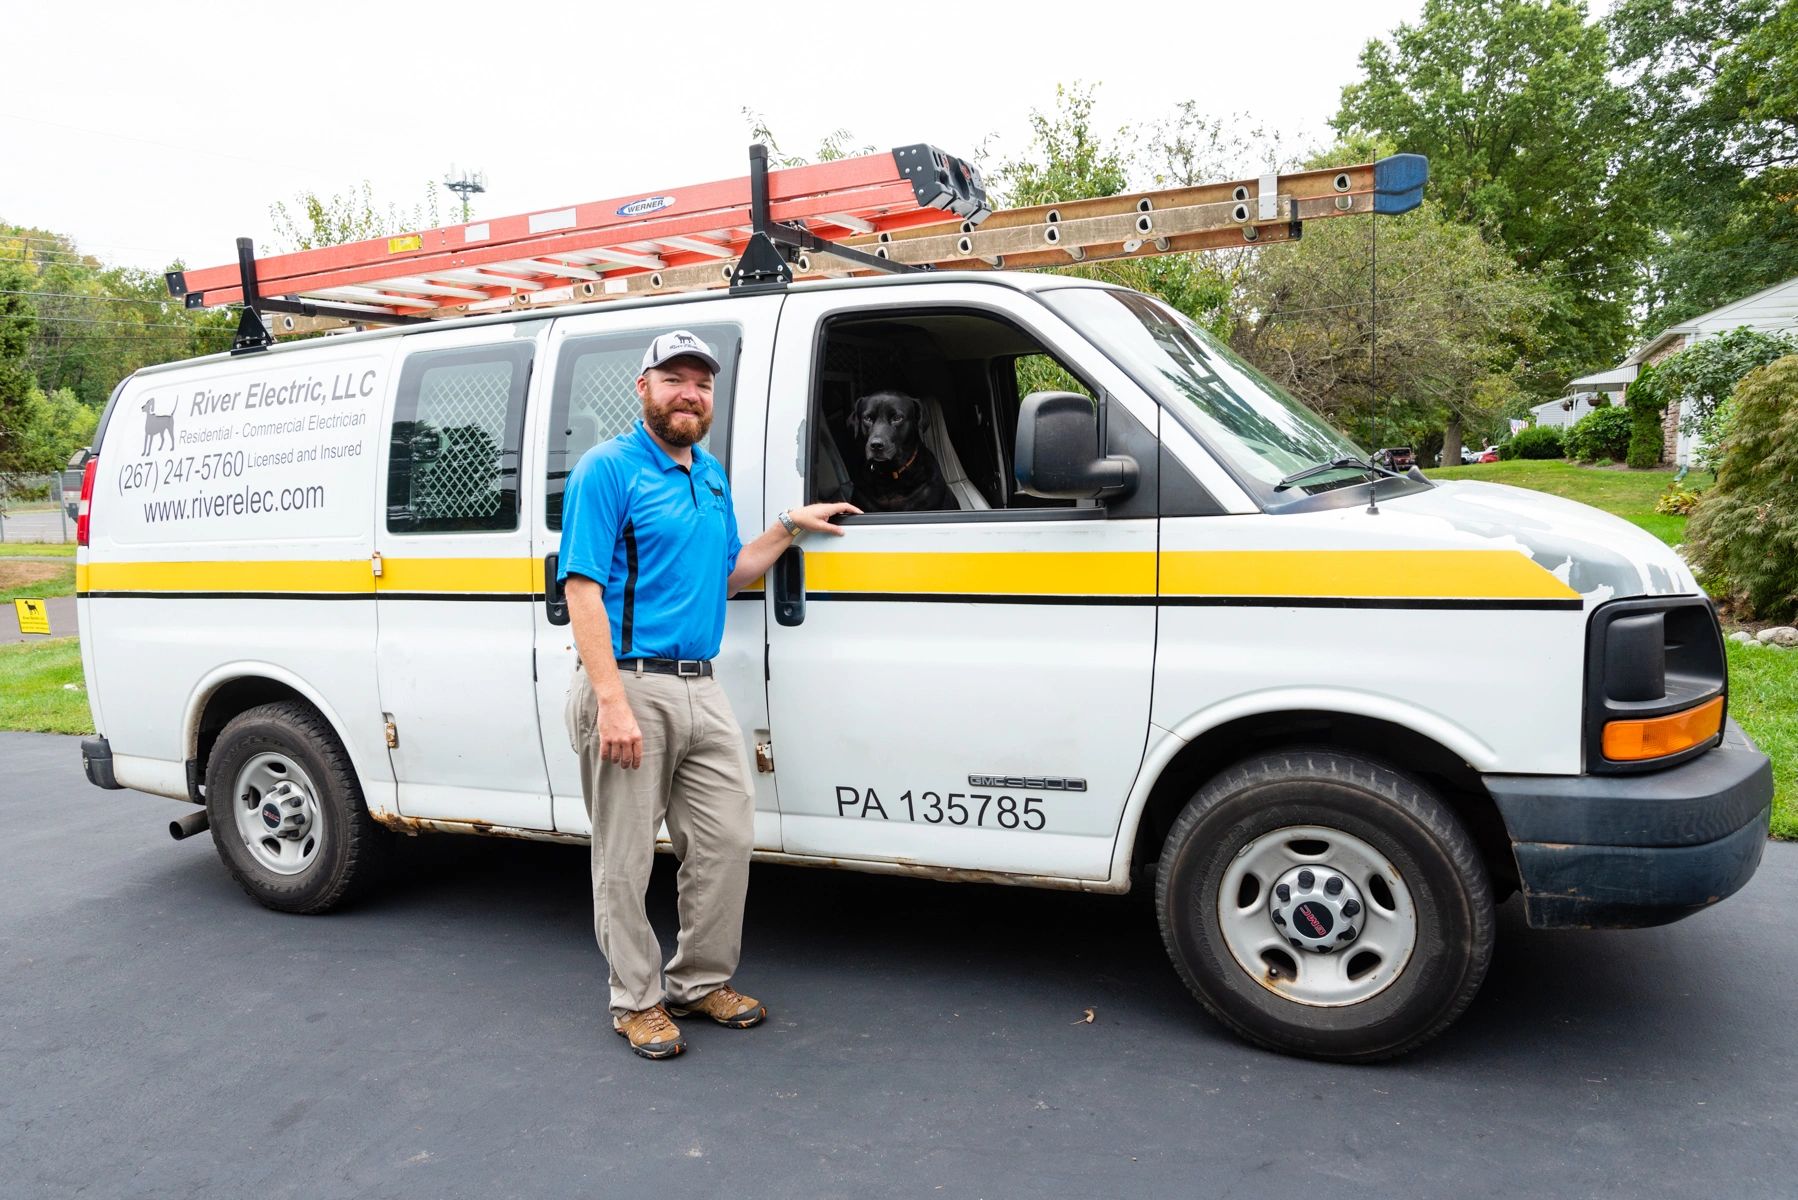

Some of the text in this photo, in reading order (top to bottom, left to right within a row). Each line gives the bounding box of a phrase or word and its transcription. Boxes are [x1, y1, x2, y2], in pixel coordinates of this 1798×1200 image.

[627, 199, 663, 213] WERNER
[190, 369, 376, 417] River Electric, LLC
[179, 426, 233, 445] Residential
[242, 416, 305, 438] Commercial
[307, 411, 366, 431] Electrician
[118, 450, 244, 496] (267) 247-5760
[247, 440, 362, 468] Licensed and Insured
[144, 485, 324, 523] www.riverelec.com
[835, 786, 1046, 831] PA 135785
